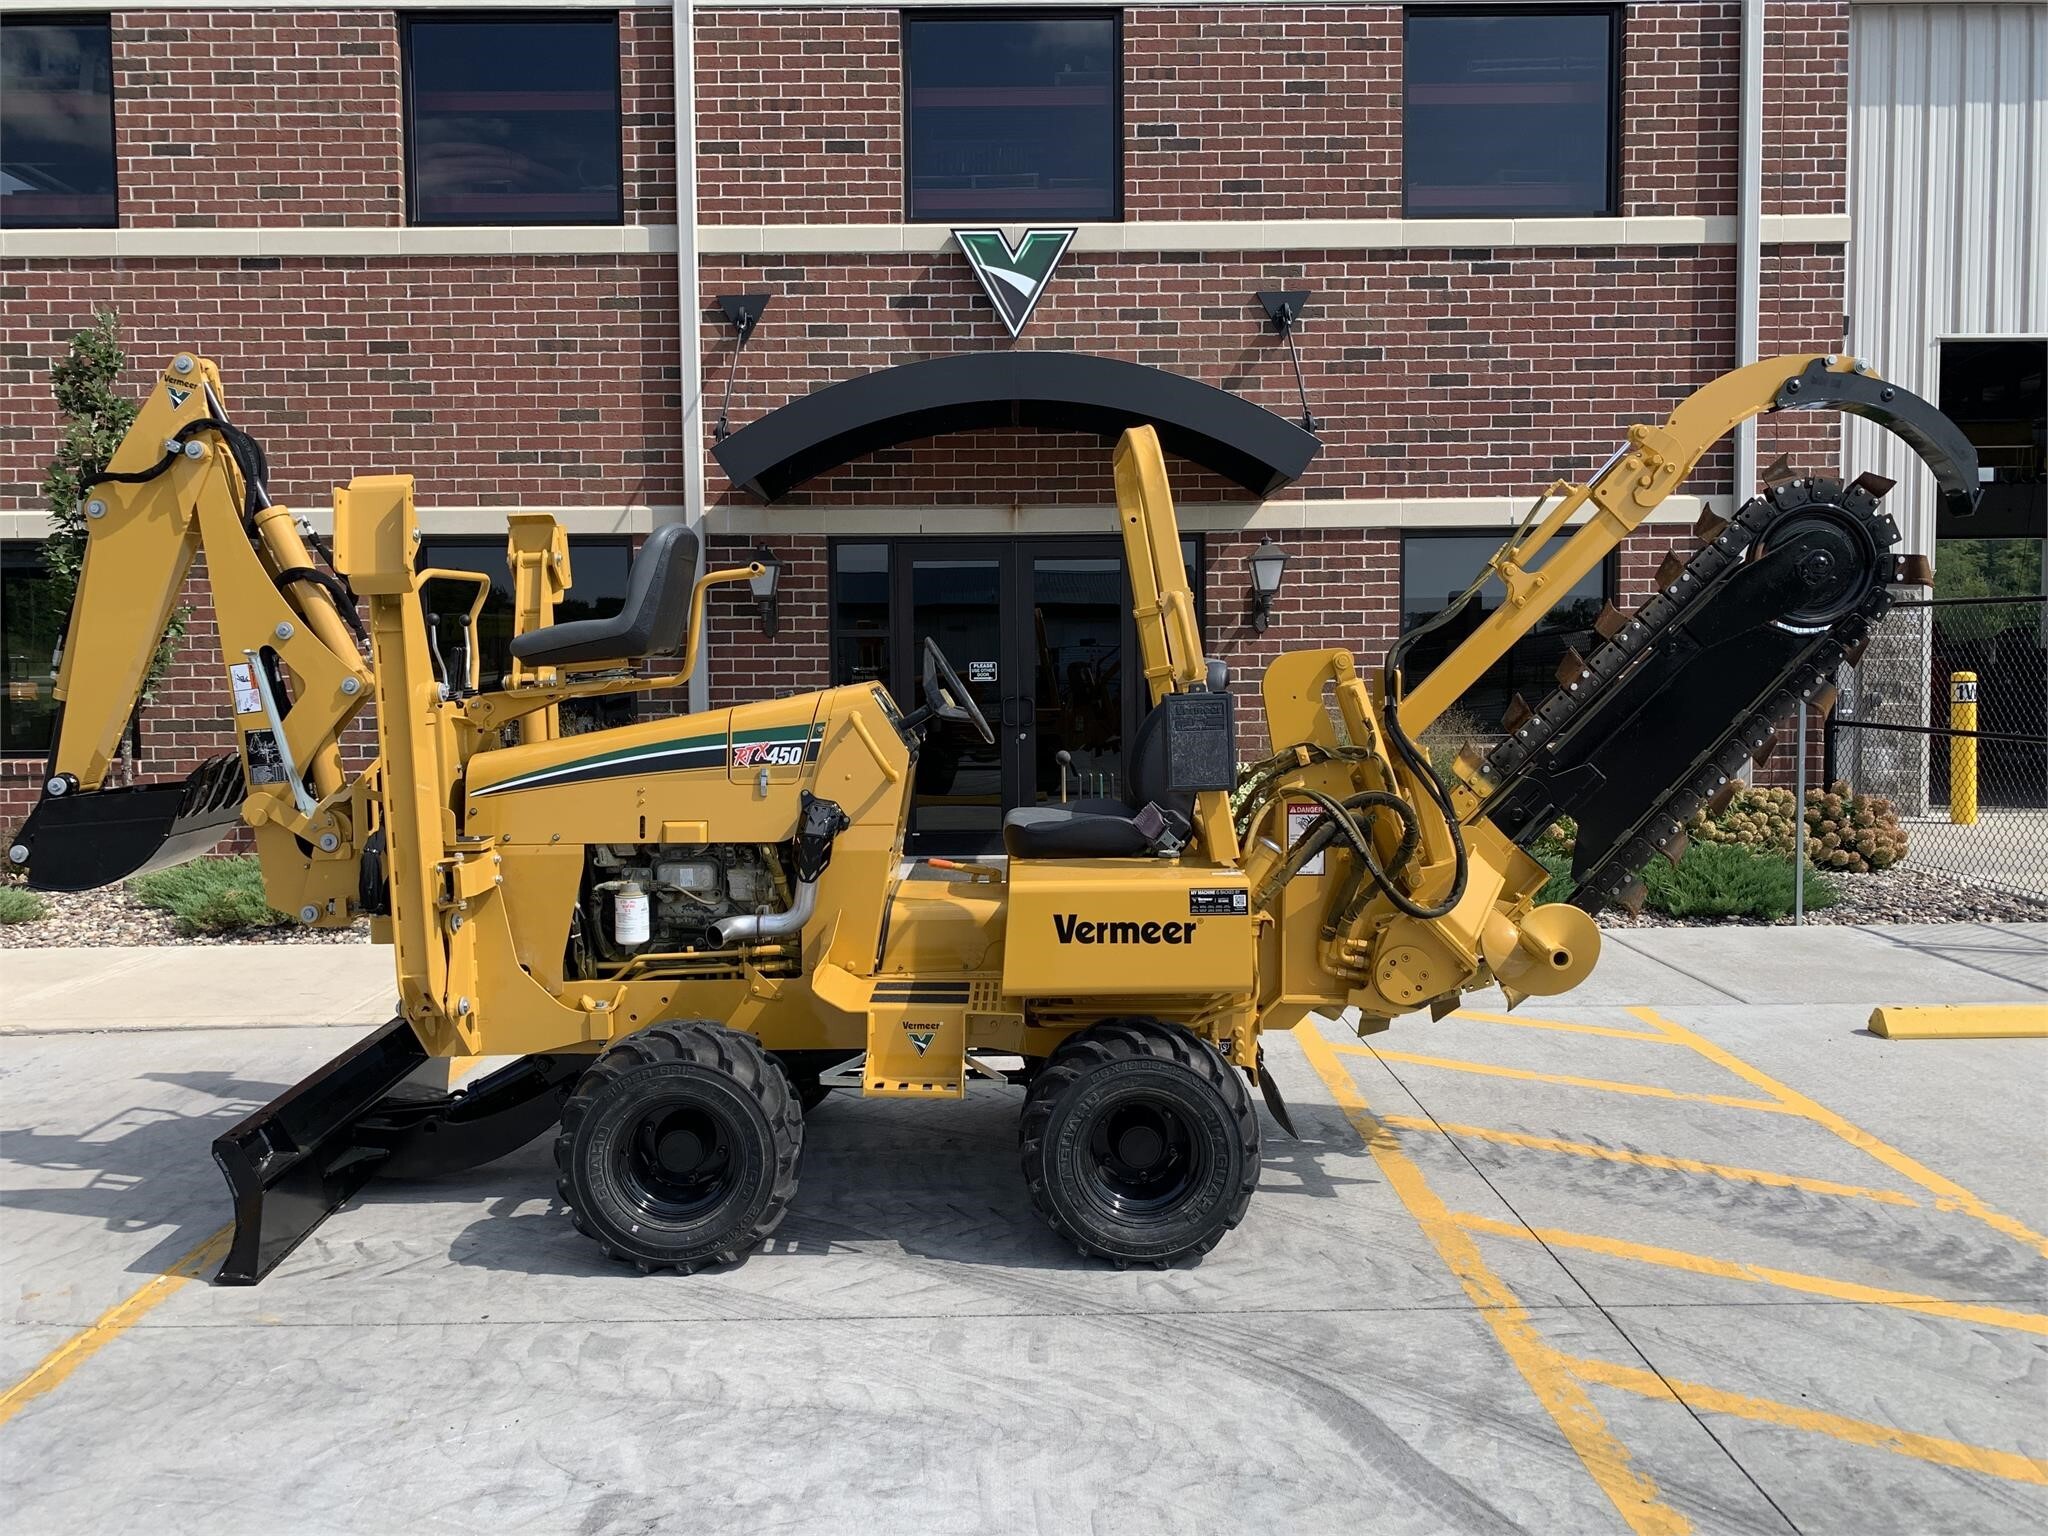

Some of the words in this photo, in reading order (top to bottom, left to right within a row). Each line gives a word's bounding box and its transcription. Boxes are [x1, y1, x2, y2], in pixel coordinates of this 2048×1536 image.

[164, 375, 198, 389] Vermeer
[1053, 913, 1196, 944] Vermeer
[902, 1021, 940, 1030] Vermeer
